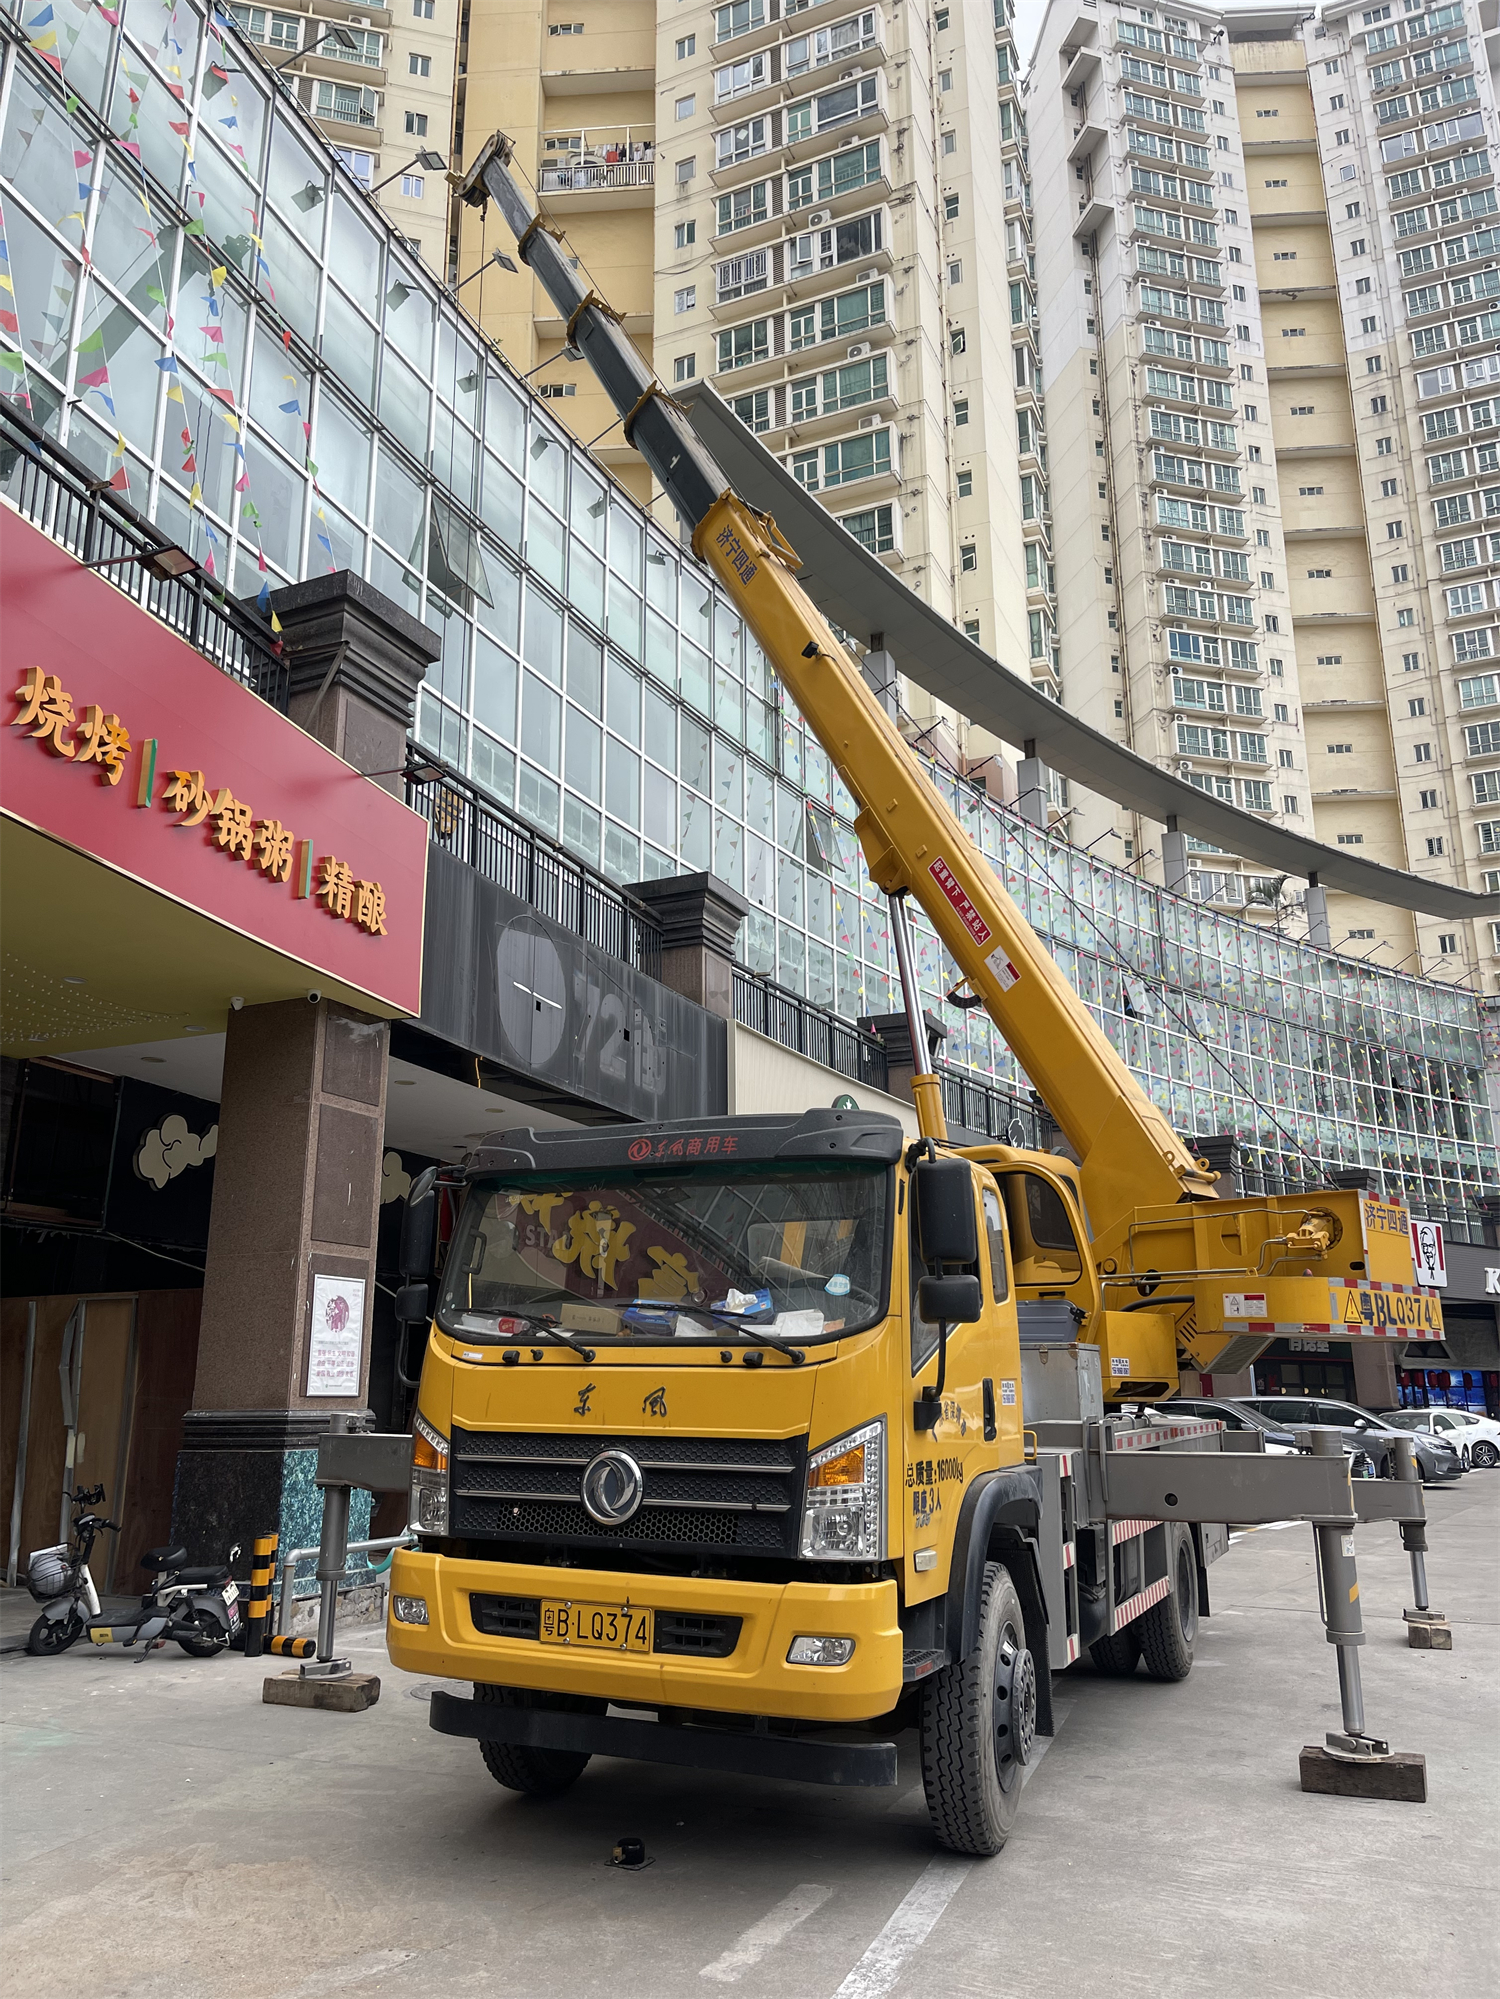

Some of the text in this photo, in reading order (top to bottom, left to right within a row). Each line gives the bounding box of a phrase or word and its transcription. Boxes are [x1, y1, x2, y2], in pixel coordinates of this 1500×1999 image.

[716, 525, 757, 585] 济宁四通
[11, 666, 388, 936] 烧烤 砂锅粥 精酿
[959, 899, 988, 941] 严禁站人
[655, 1135, 739, 1158] 东风商用车
[1364, 1202, 1409, 1236] 济宁四通
[1359, 1290, 1434, 1328] 粤BLQ374
